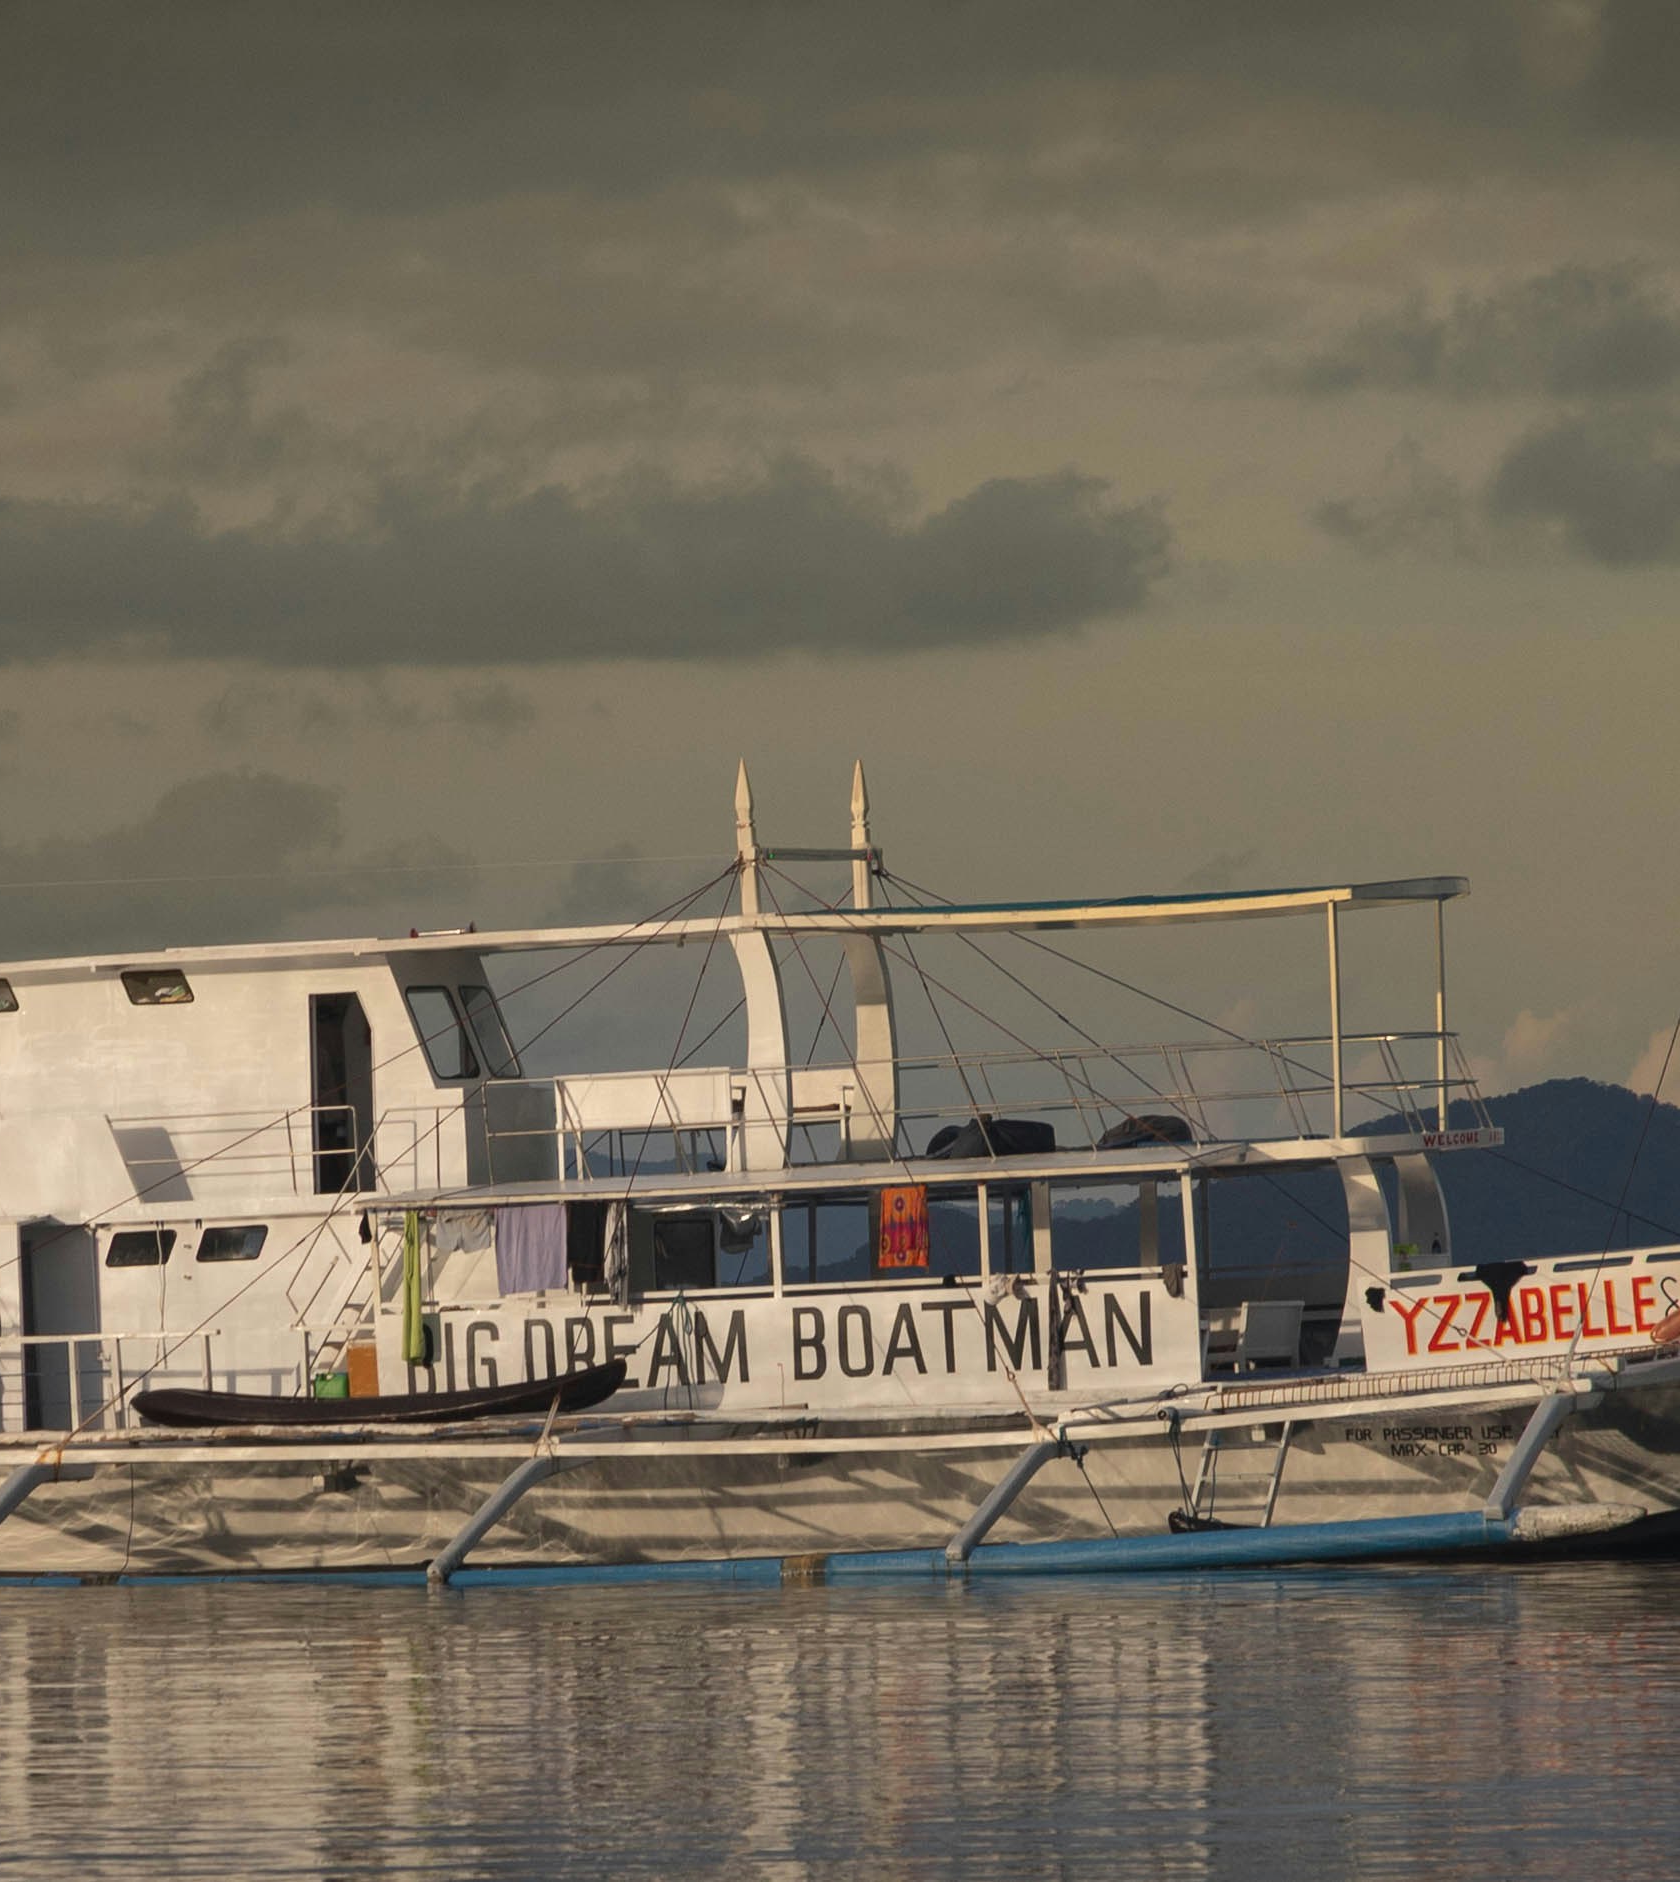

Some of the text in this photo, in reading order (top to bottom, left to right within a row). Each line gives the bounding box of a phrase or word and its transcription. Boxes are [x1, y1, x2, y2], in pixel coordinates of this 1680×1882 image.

[1423, 1131, 1480, 1148] WELCOME
[1389, 1275, 1657, 1356] YZZABELLE
[524, 1309, 750, 1389] DREAM
[792, 1290, 1153, 1382] BOATMAN
[1346, 1428, 1373, 1442] FOR
[1383, 1426, 1473, 1441] PASSENGER
[1481, 1425, 1515, 1440] USE
[1478, 1442, 1498, 1456] 30
